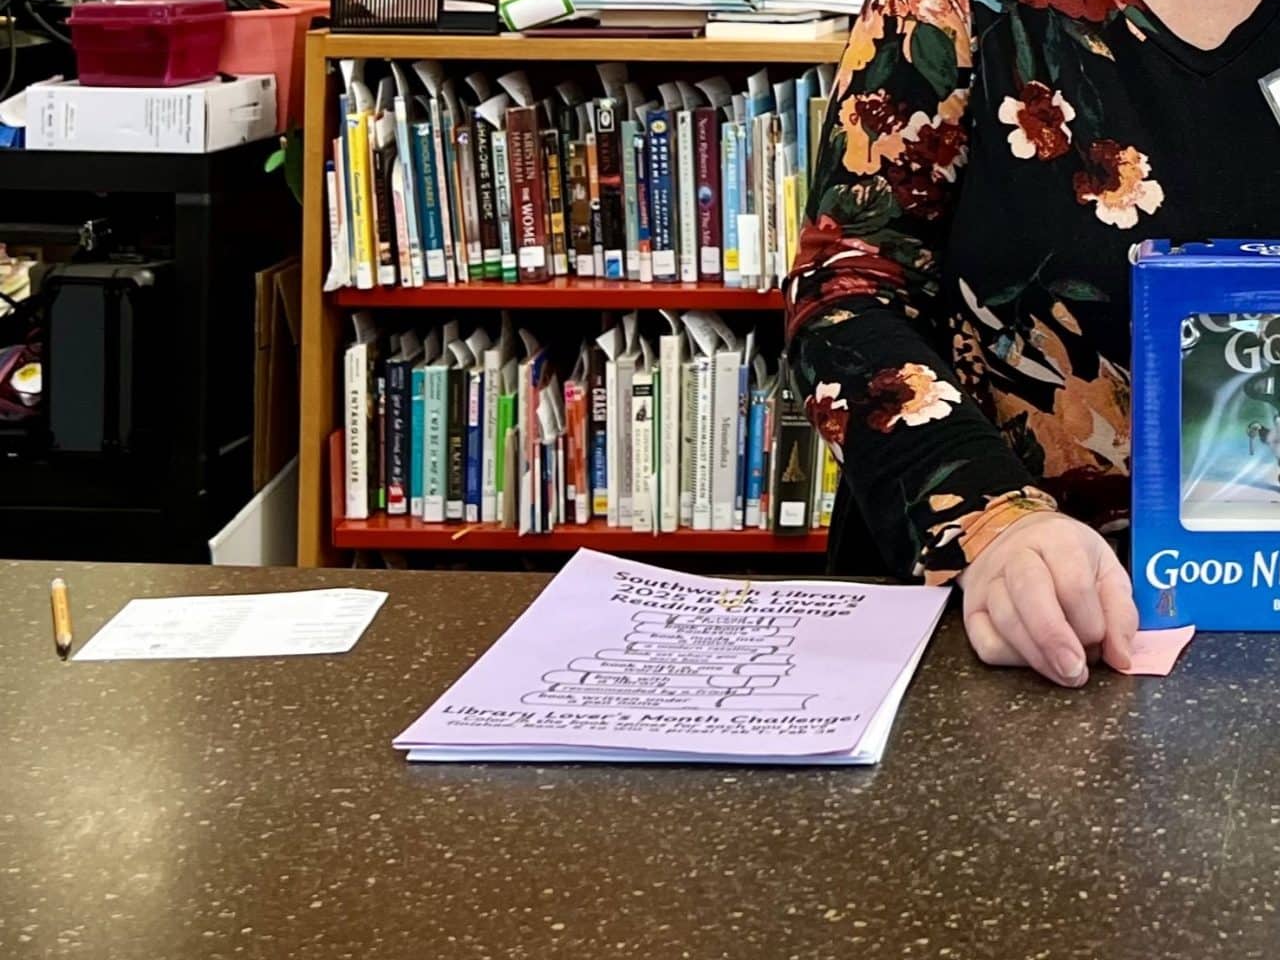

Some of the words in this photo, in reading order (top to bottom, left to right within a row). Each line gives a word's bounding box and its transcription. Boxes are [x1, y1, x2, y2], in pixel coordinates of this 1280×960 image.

[512, 132, 523, 183] HANNAH
[523, 132, 536, 180] KRISTIN
[521, 203, 535, 246] WOME
[351, 390, 359, 455] ENTANGLED
[592, 388, 606, 421] CRASH
[720, 417, 731, 469] Minimalista
[351, 460, 359, 484] LIFE
[614, 571, 760, 596] Southworth
[771, 590, 867, 602] Library
[1145, 549, 1243, 589] GOOD
[611, 594, 715, 614] Reading
[725, 604, 852, 617] Challenge
[616, 584, 686, 602] 2025
[770, 597, 858, 608] Lover's
[442, 705, 536, 720] Library
[545, 711, 631, 721] Lover's
[641, 714, 719, 724] Month
[730, 714, 861, 725] Challenge!
